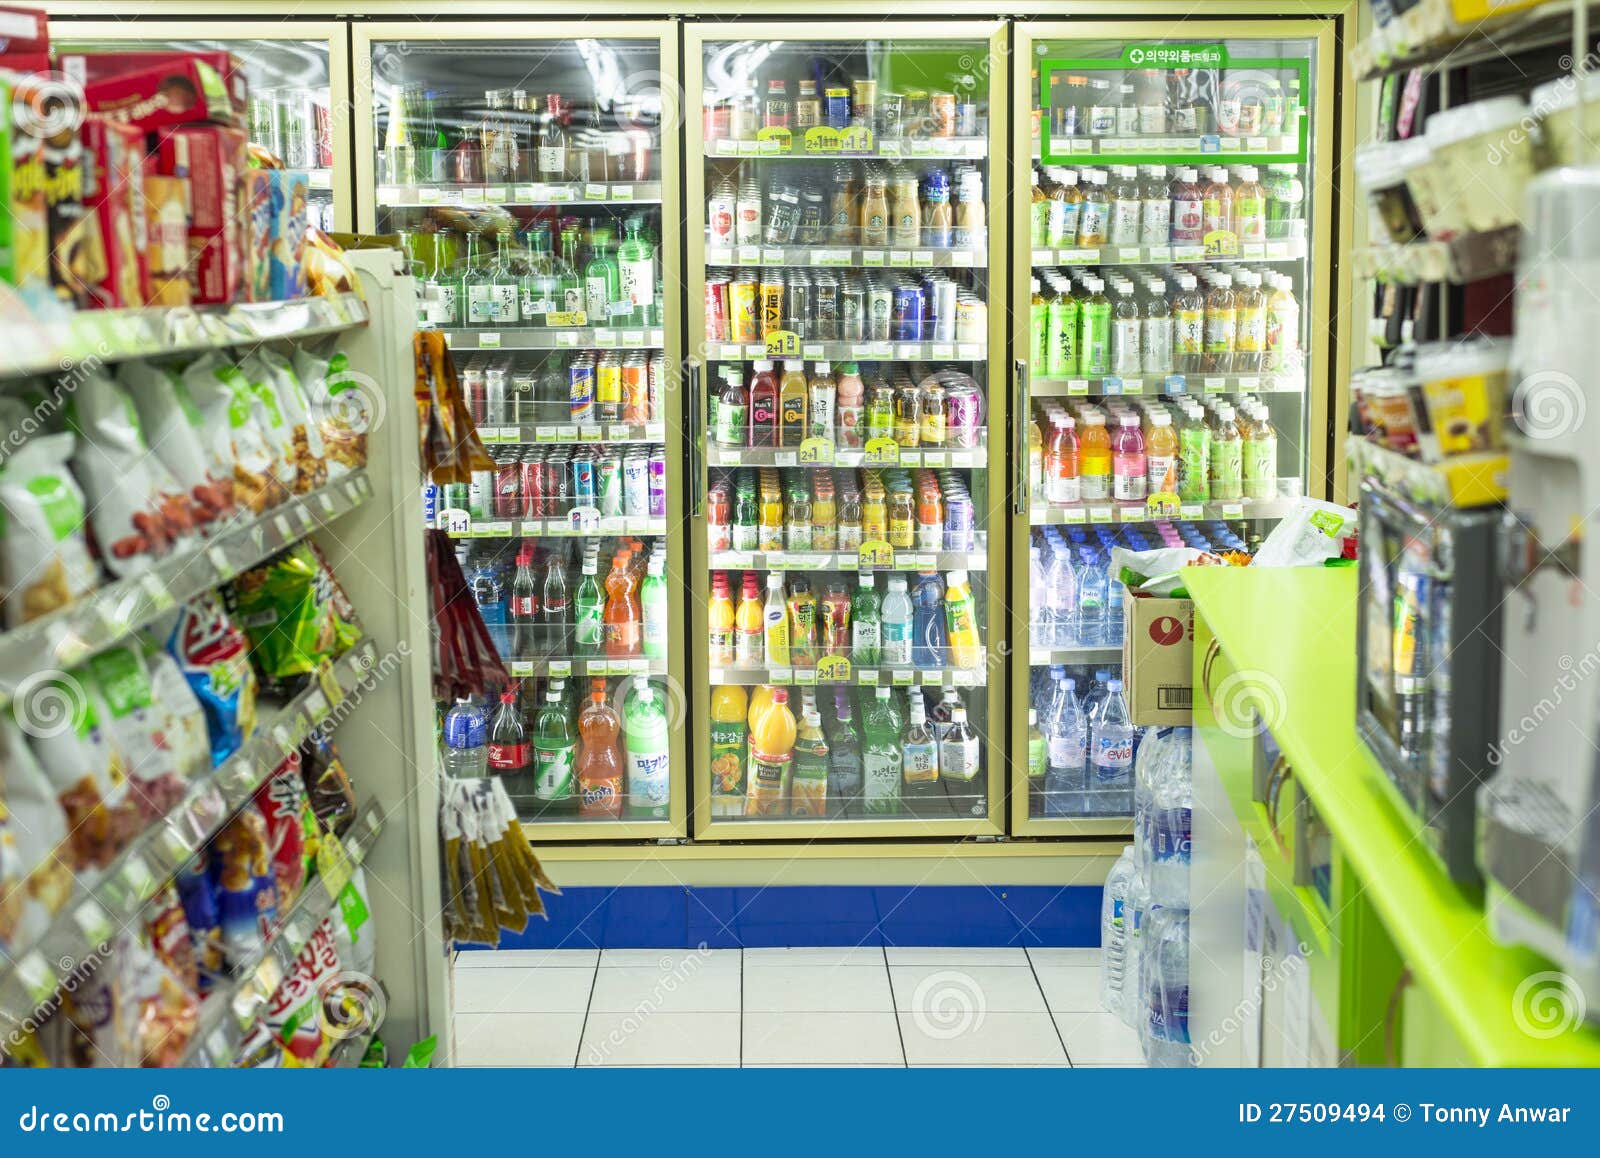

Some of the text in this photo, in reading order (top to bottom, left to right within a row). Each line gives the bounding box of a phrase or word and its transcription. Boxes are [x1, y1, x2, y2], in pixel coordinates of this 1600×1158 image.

[807, 135, 822, 149] 2+1
[1206, 239, 1221, 253] 2+1
[767, 339, 783, 353] 2+1
[801, 447, 817, 461] 2+1
[866, 447, 882, 461] 2+1
[452, 519, 468, 532] 1+1
[861, 549, 877, 563] 2+1
[818, 664, 834, 678] 2+1
[1108, 748, 1131, 761] evia
[871, 765, 898, 778] 자연은
